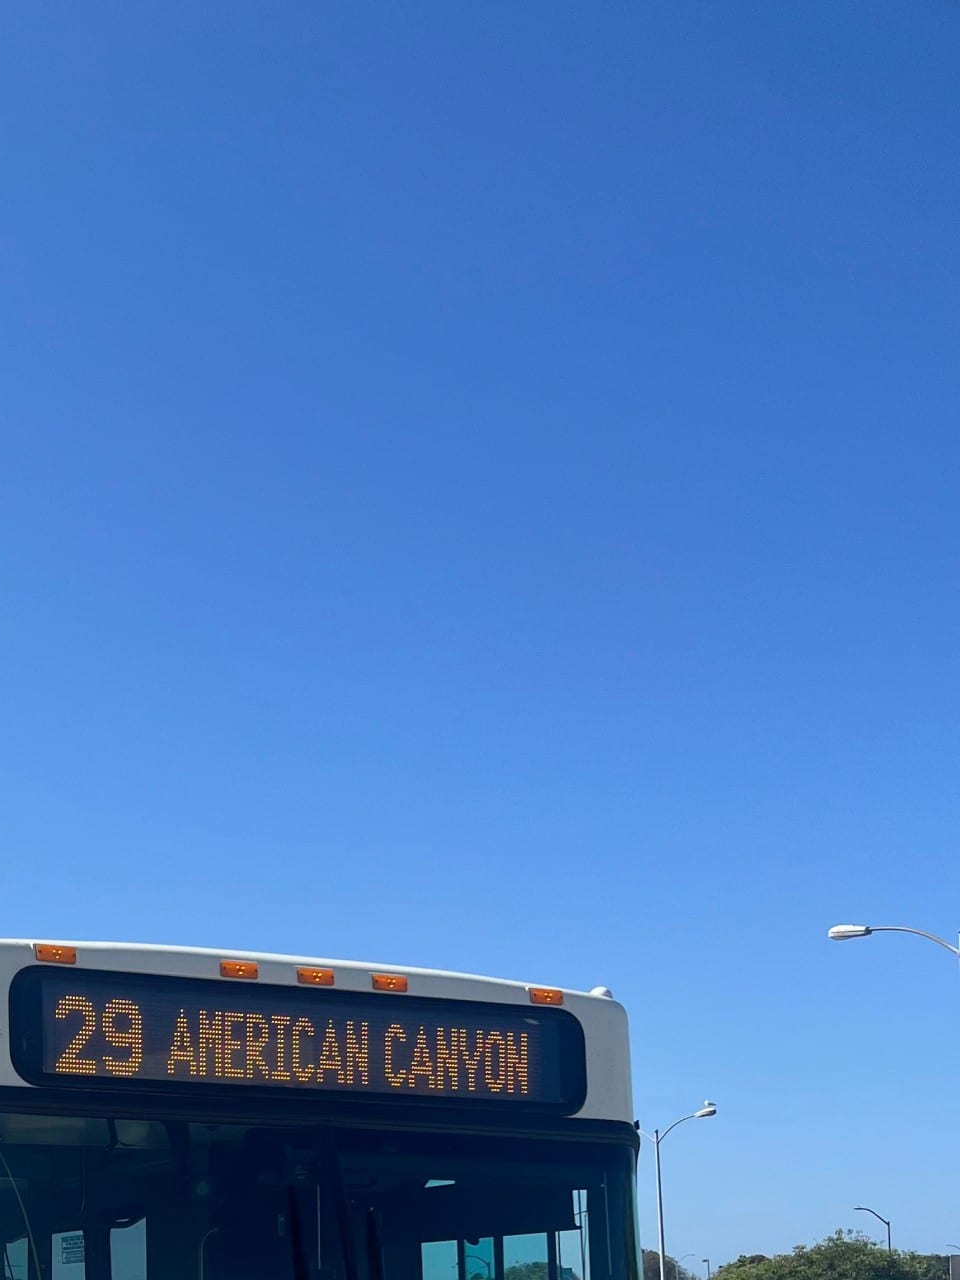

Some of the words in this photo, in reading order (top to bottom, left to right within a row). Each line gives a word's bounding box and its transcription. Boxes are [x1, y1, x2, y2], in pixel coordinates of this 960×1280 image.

[55, 996, 142, 1076] 29
[167, 1008, 369, 1084] AMERICAN
[384, 1024, 528, 1094] CANYON
